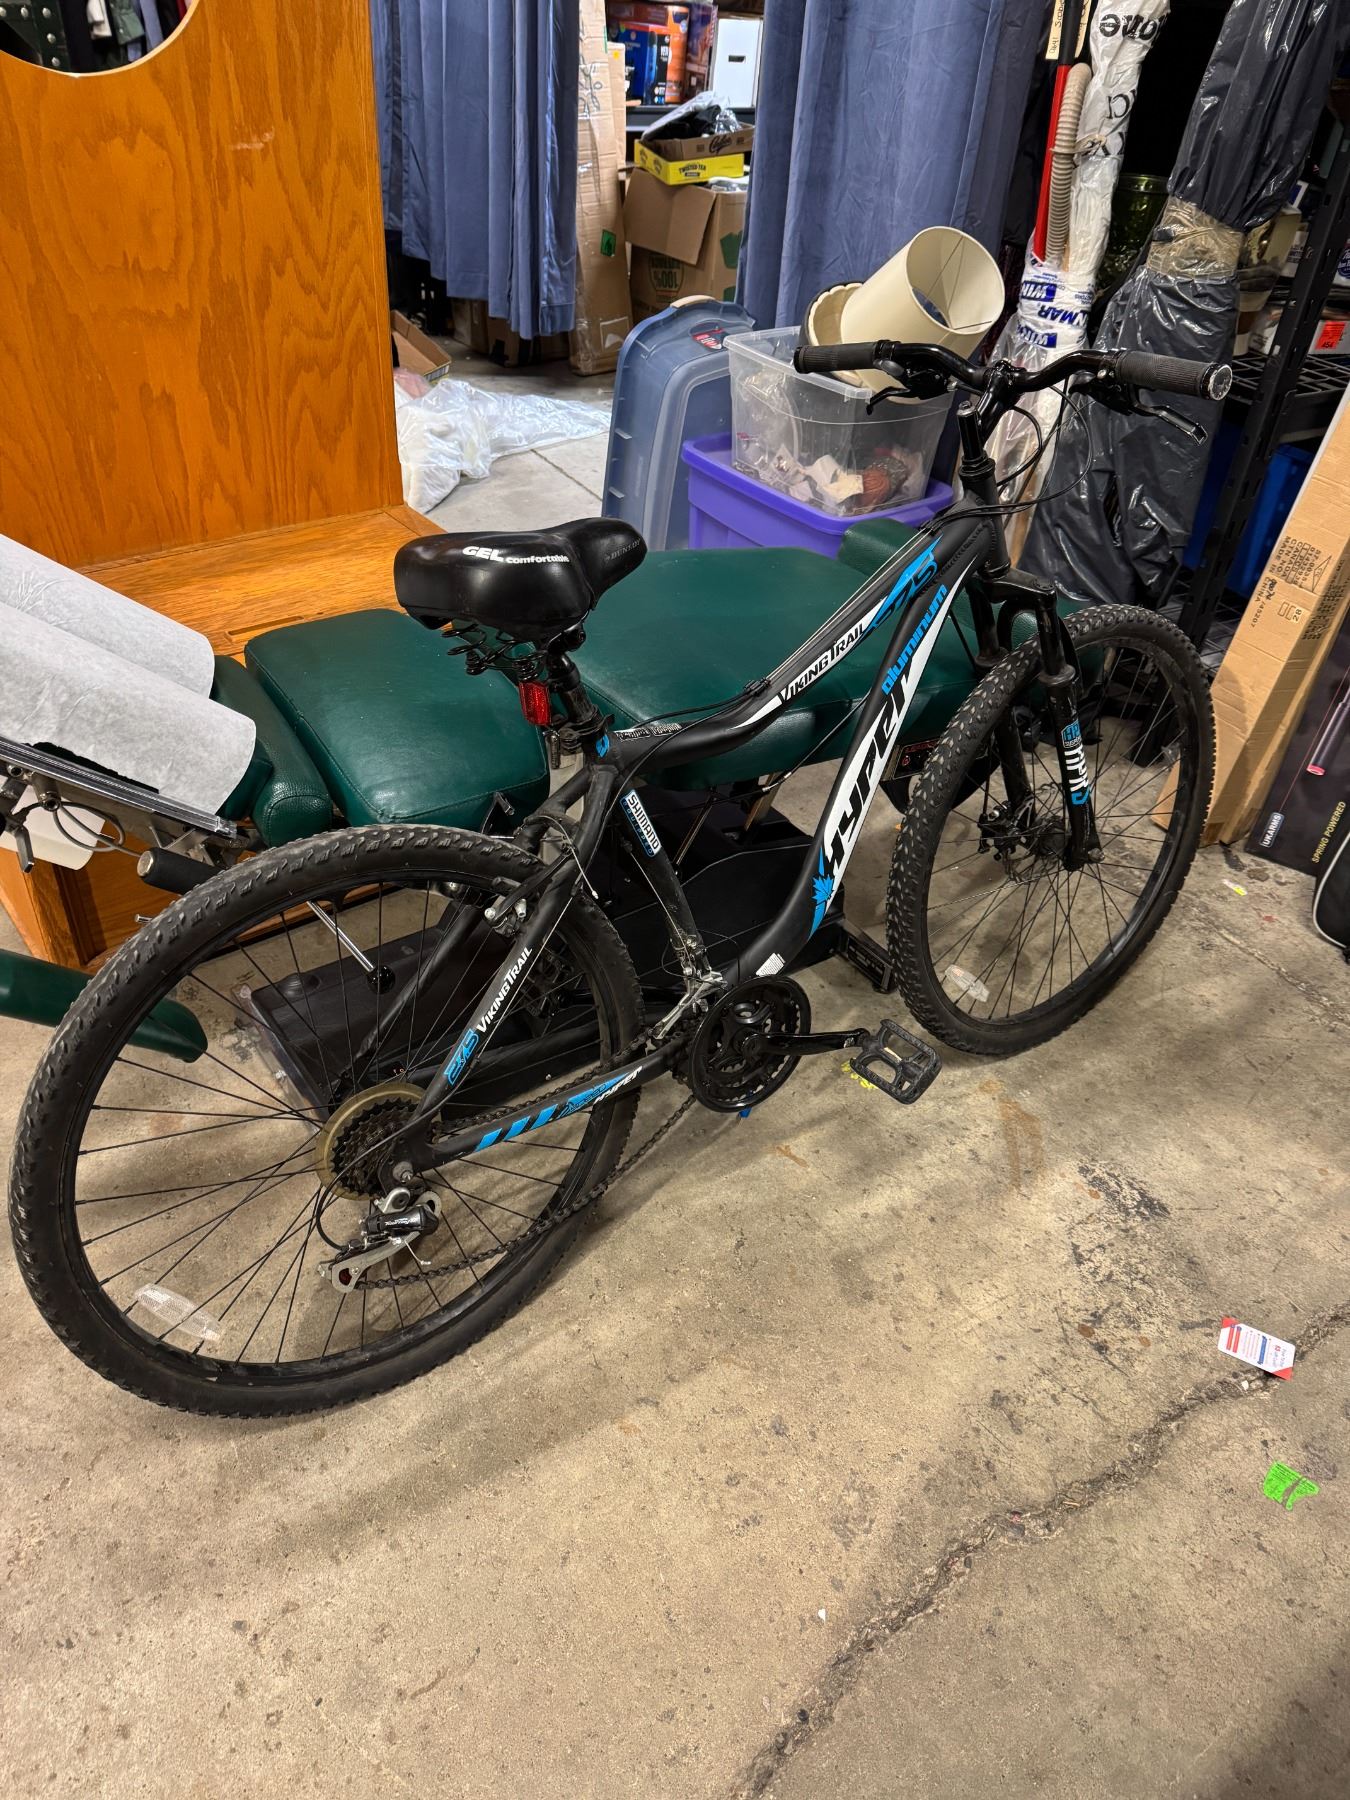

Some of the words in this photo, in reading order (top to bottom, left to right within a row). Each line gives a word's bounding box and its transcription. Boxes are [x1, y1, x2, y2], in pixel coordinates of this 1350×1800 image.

[462, 546, 504, 562] GEL
[505, 555, 570, 564] comfortable
[1276, 536, 1291, 560] MADE
[1281, 541, 1303, 578] CANADA
[1285, 539, 1297, 556] CTN
[1269, 564, 1277, 573] IN
[1255, 576, 1270, 602] CHINA
[628, 794, 661, 850] SHIMANO
[1262, 814, 1281, 845] UKARMS
[1312, 837, 1329, 863] SPRING
[1324, 801, 1346, 837] POWERED
